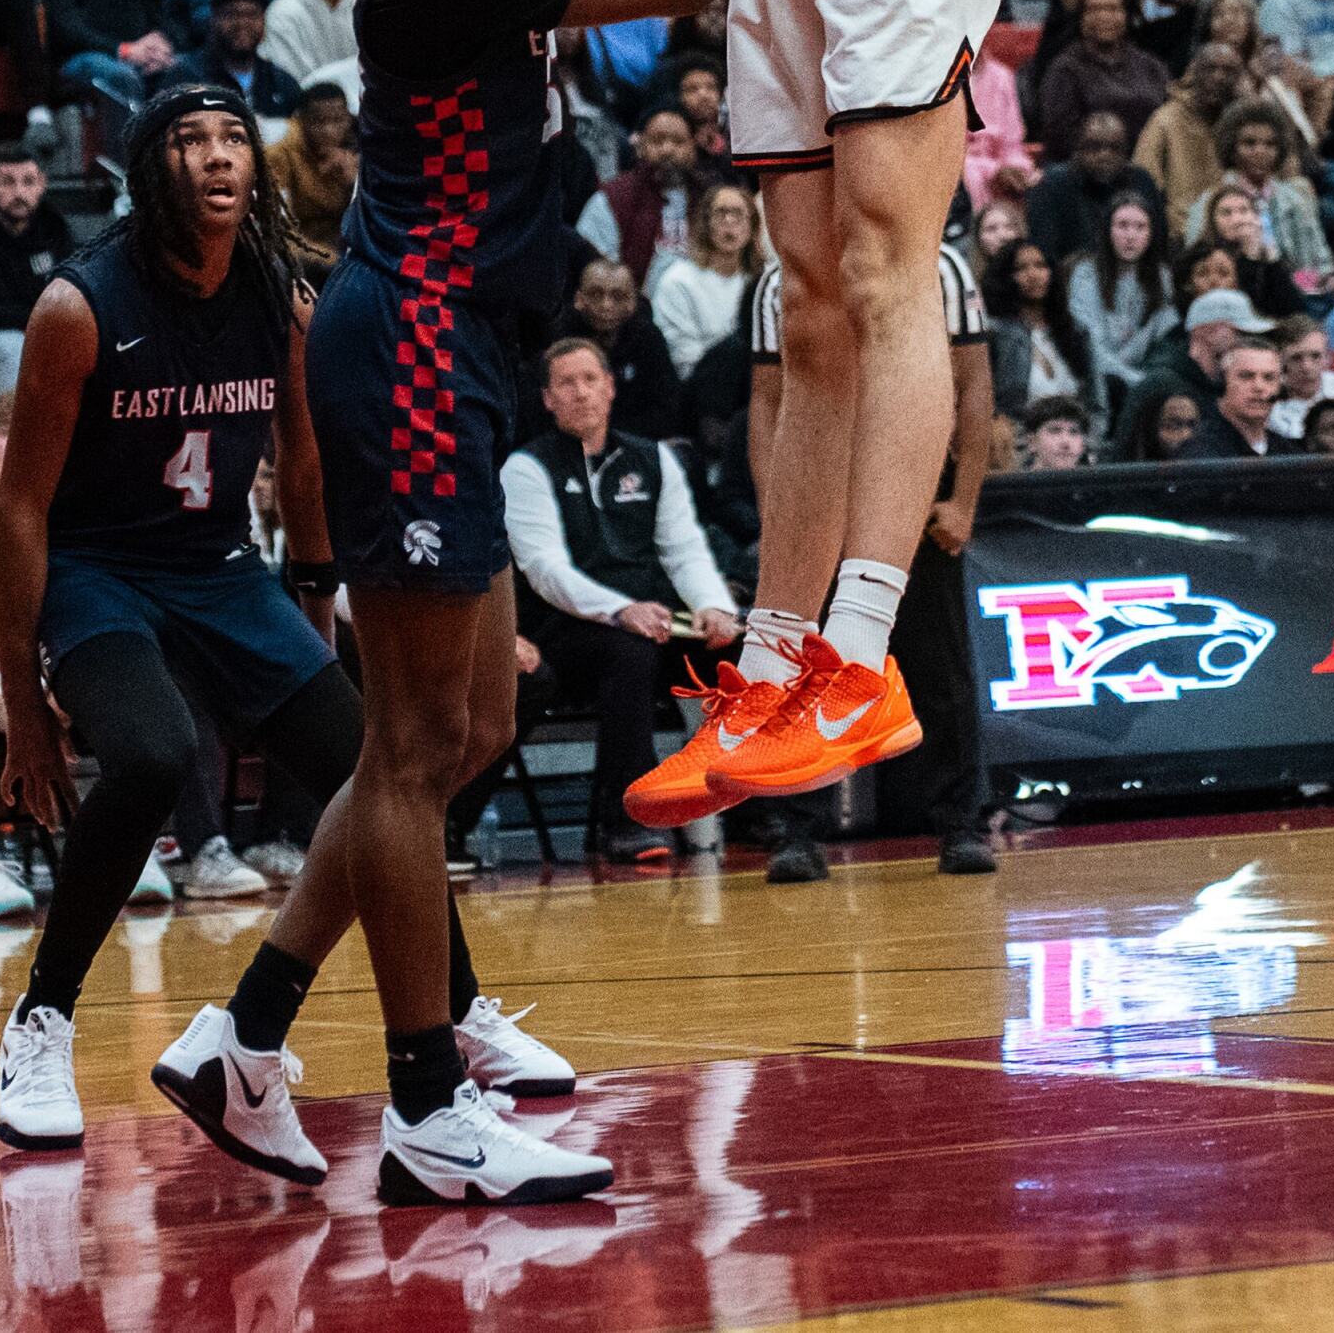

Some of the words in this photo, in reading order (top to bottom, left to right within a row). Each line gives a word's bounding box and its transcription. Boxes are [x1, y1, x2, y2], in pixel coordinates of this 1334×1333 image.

[111, 386, 176, 419] EAST
[178, 377, 275, 417] LANSING
[162, 428, 214, 510] 4
